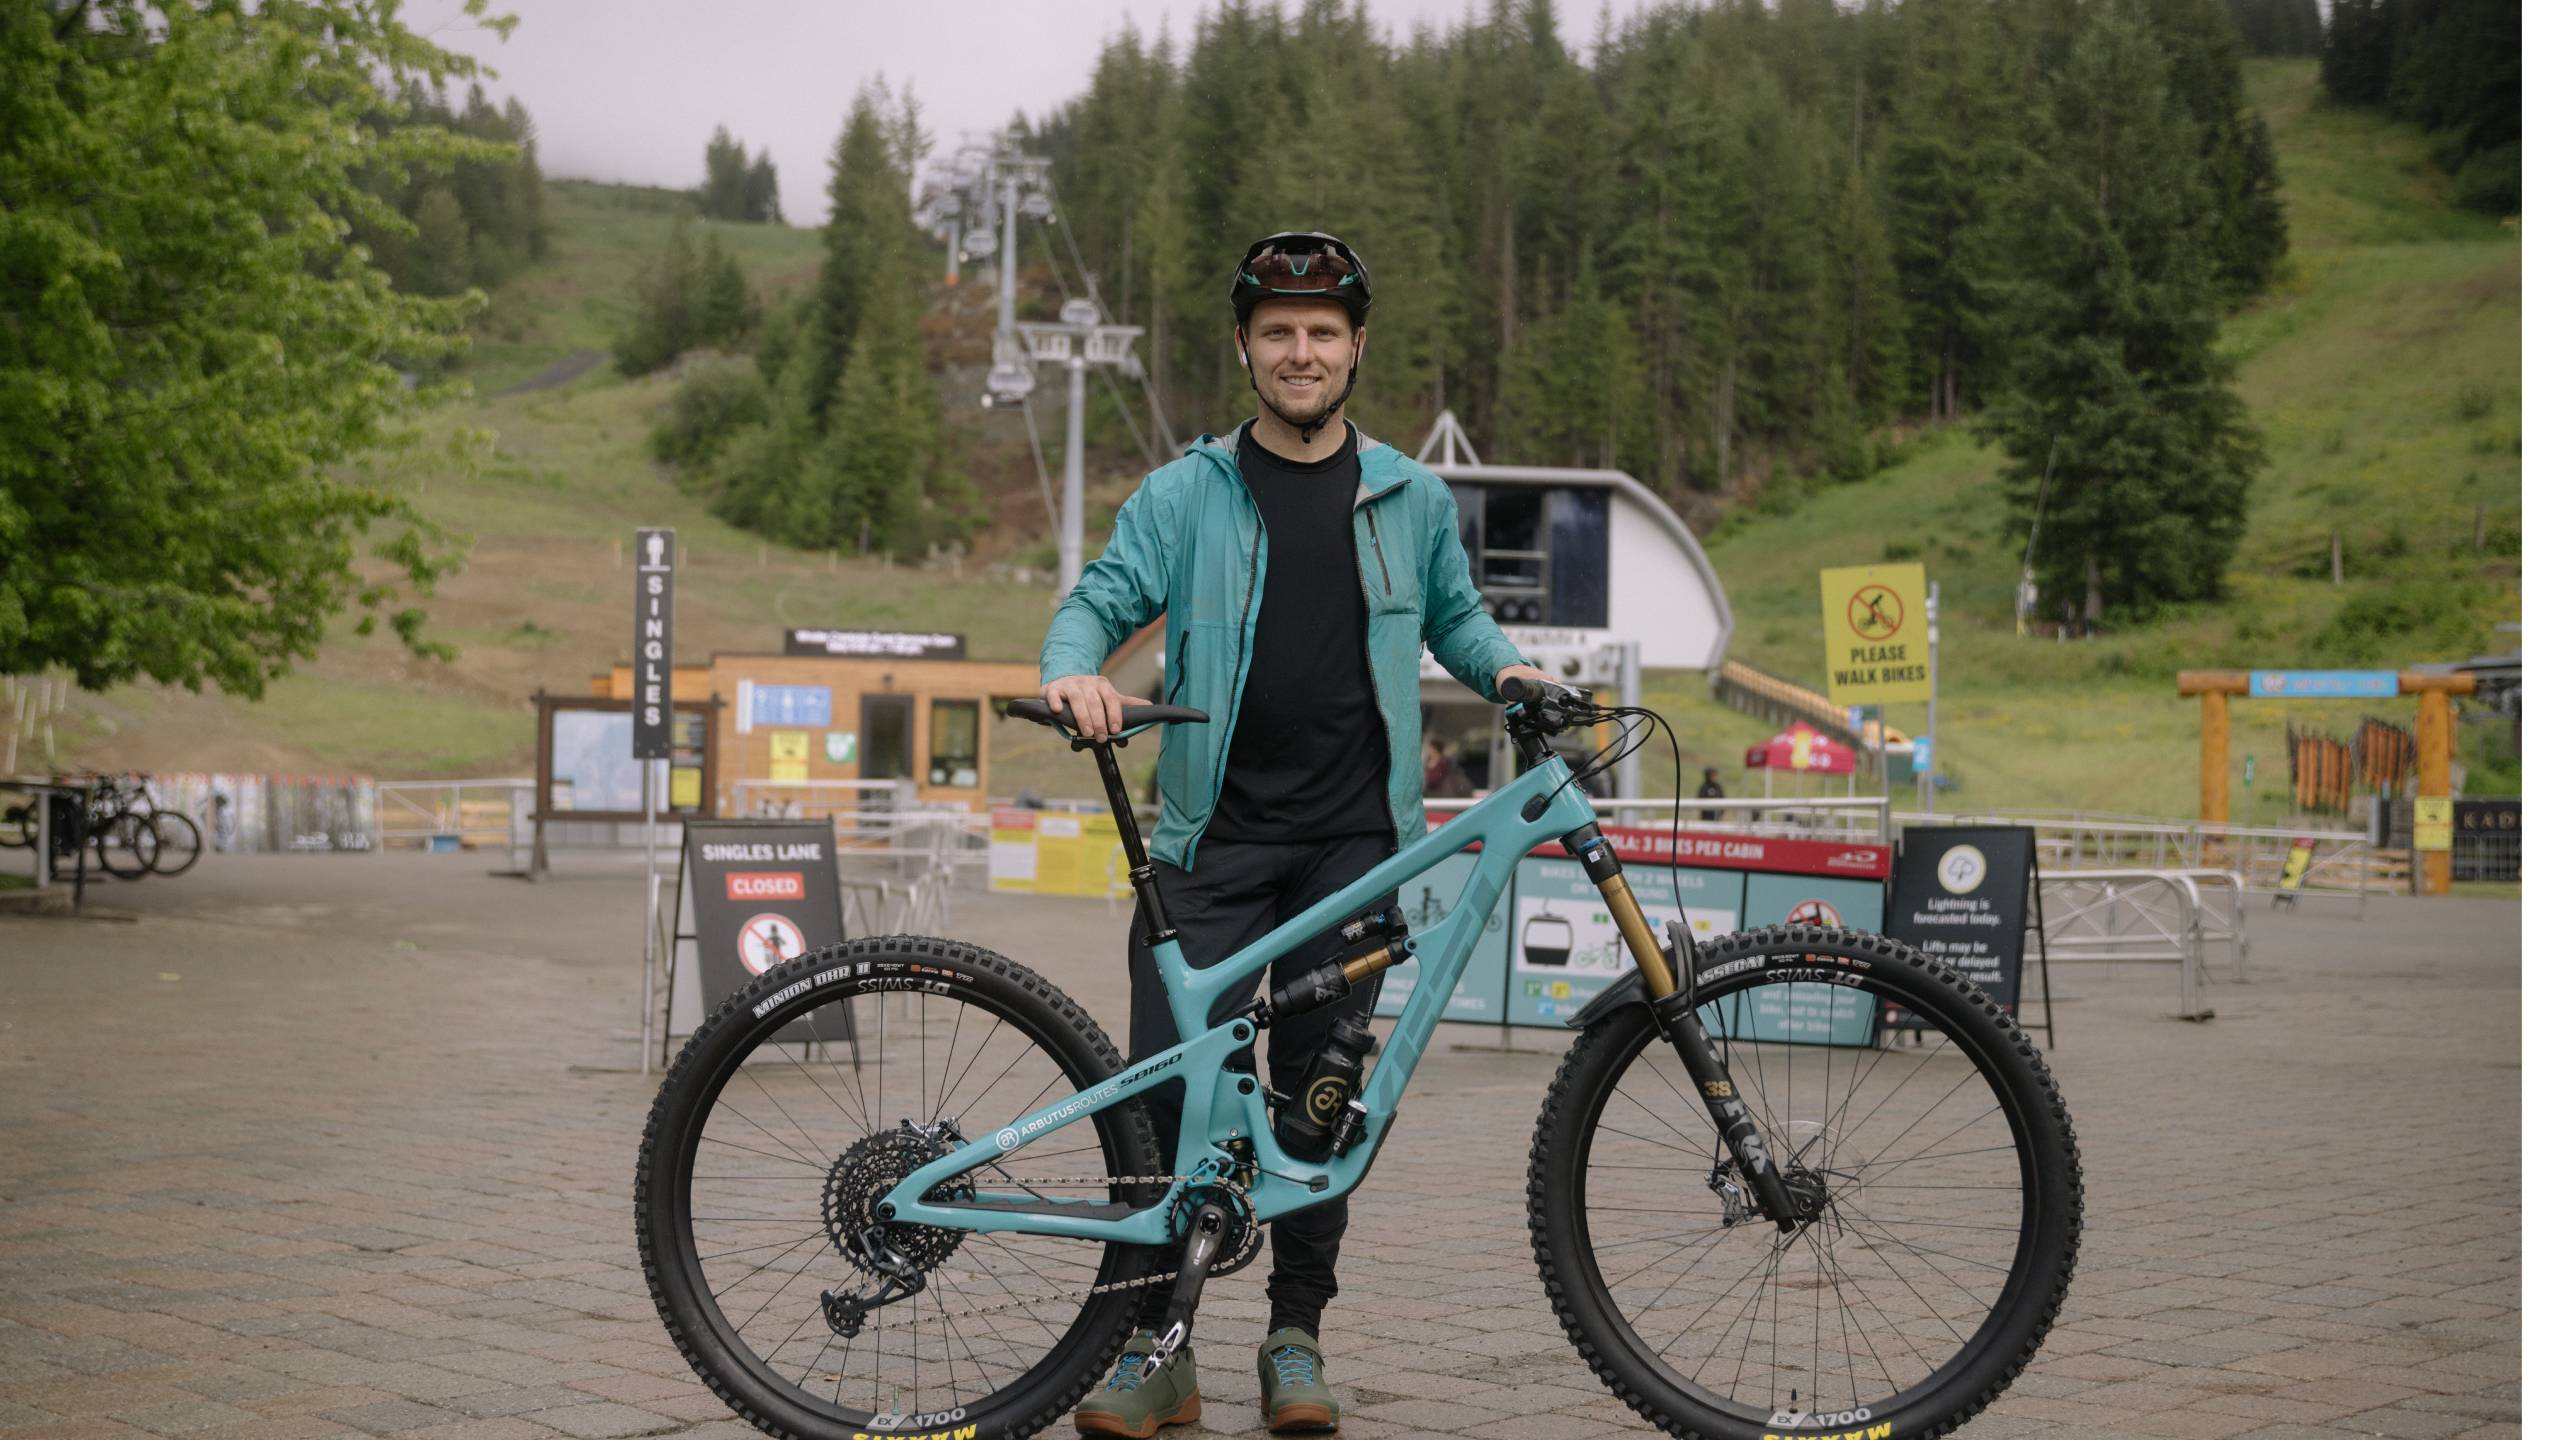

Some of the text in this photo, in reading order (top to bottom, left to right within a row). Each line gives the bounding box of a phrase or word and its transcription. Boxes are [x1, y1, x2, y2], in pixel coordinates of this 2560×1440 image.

[644, 575, 663, 726] SINGLES
[1850, 645, 1907, 663] PLEASE
[1834, 666, 1925, 686] WALK BIKES
[702, 843, 822, 861] SINGLES LANE
[1655, 838, 1694, 855] BIKES
[1696, 840, 1720, 856] PER
[1724, 842, 1764, 859] CABIN
[733, 878, 798, 895] CLOSED
[1928, 898, 1990, 912] Lightning is
[1914, 911, 2001, 927] forecasted today.
[1923, 940, 1988, 954] Lifts may be
[1958, 955, 2000, 969] delayed
[858, 977, 951, 995] DT SWISS
[1766, 968, 1865, 987] DT SWISS
[753, 977, 812, 1019] MINION
[814, 965, 852, 987] DHR
[856, 961, 871, 976] II
[1120, 1052, 1183, 1089] SB160
[1703, 1081, 1733, 1097] 38
[877, 1407, 966, 1427] EX 1700
[1777, 1408, 1872, 1427] EX 1700
